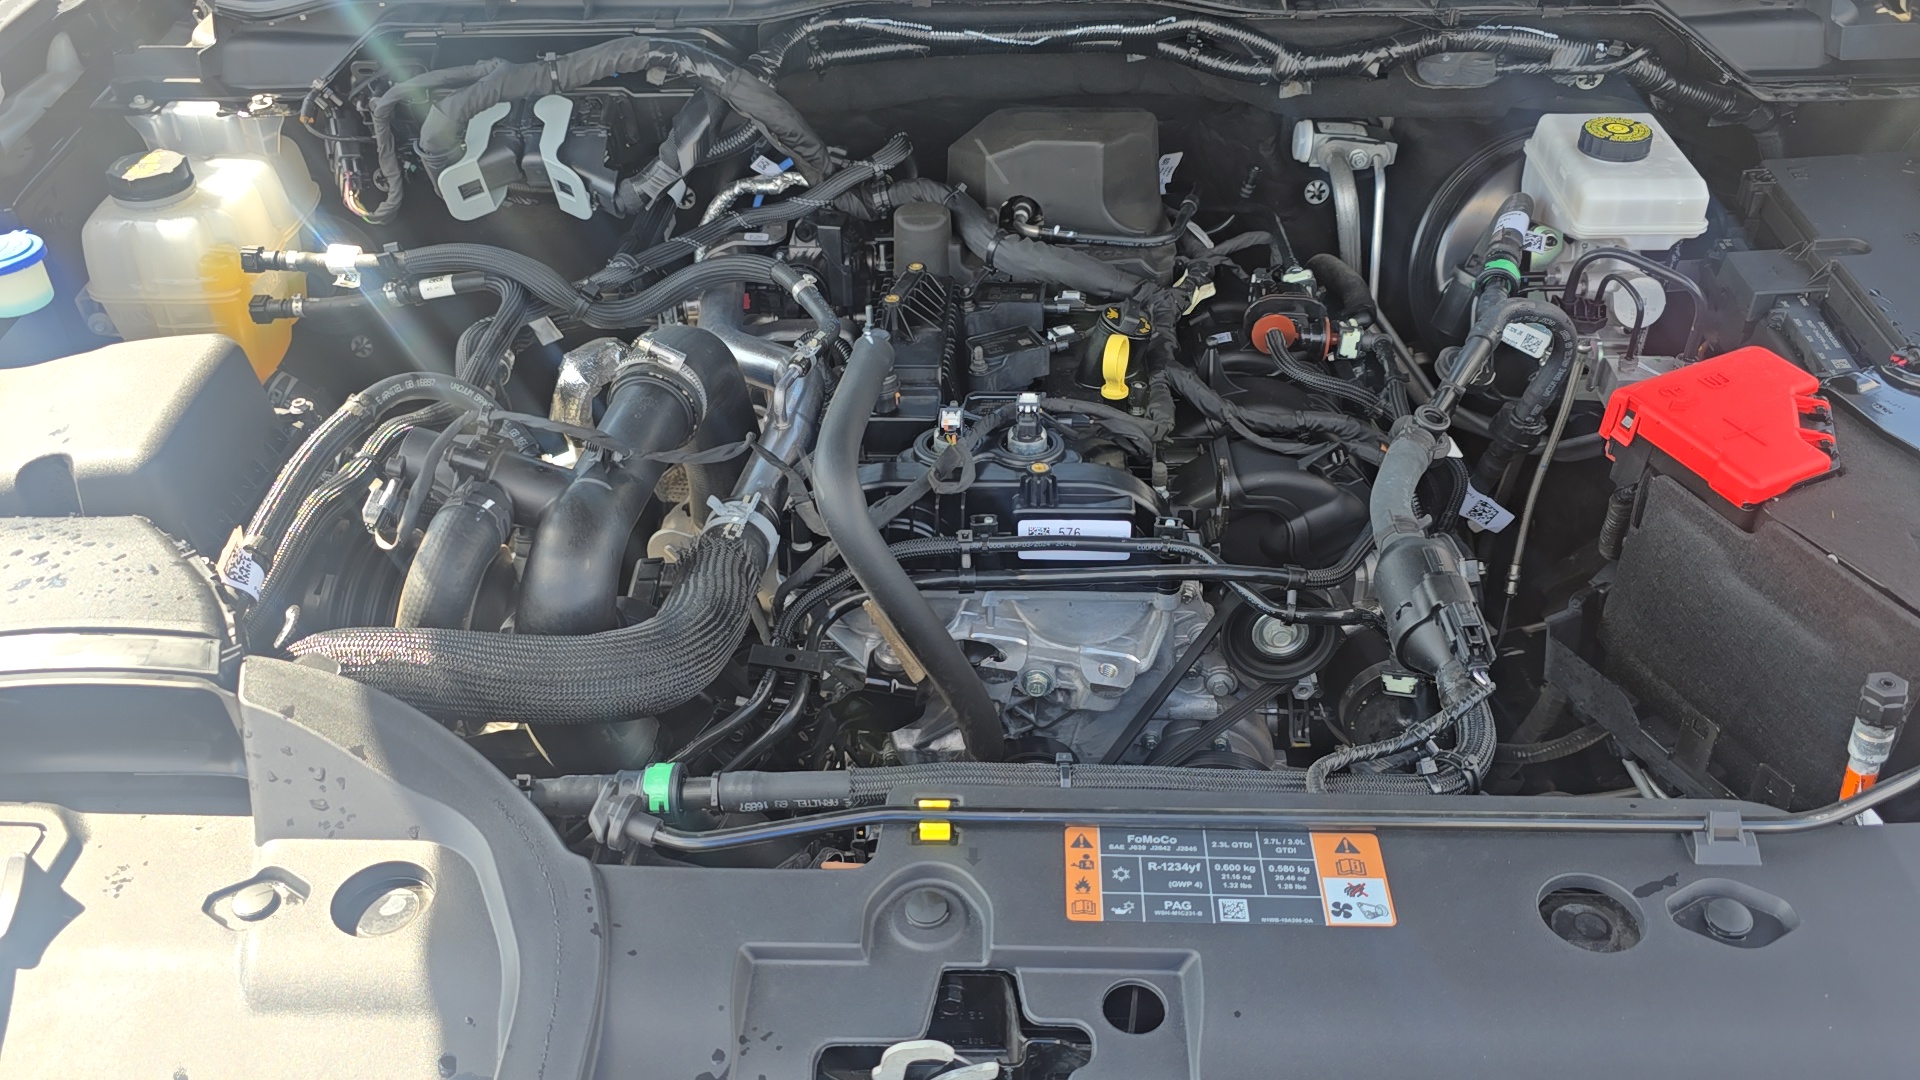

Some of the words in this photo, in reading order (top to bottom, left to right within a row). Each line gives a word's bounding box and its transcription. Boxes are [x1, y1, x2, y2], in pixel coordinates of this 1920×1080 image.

[1127, 834, 1177, 844] FoMoCo
[1287, 838, 1306, 846] 3.0L
[1231, 841, 1253, 849] GTDI
[1275, 846, 1297, 854] GTDI
[1147, 861, 1201, 874] R-1234yf
[1214, 863, 1241, 872] 0.600
[1243, 863, 1256, 874] kg
[1268, 864, 1295, 873] 0.580
[1297, 865, 1310, 875] kg
[1168, 880, 1193, 888] (GWP
[1194, 881, 1204, 889] 4)
[1164, 900, 1192, 910] PAG
